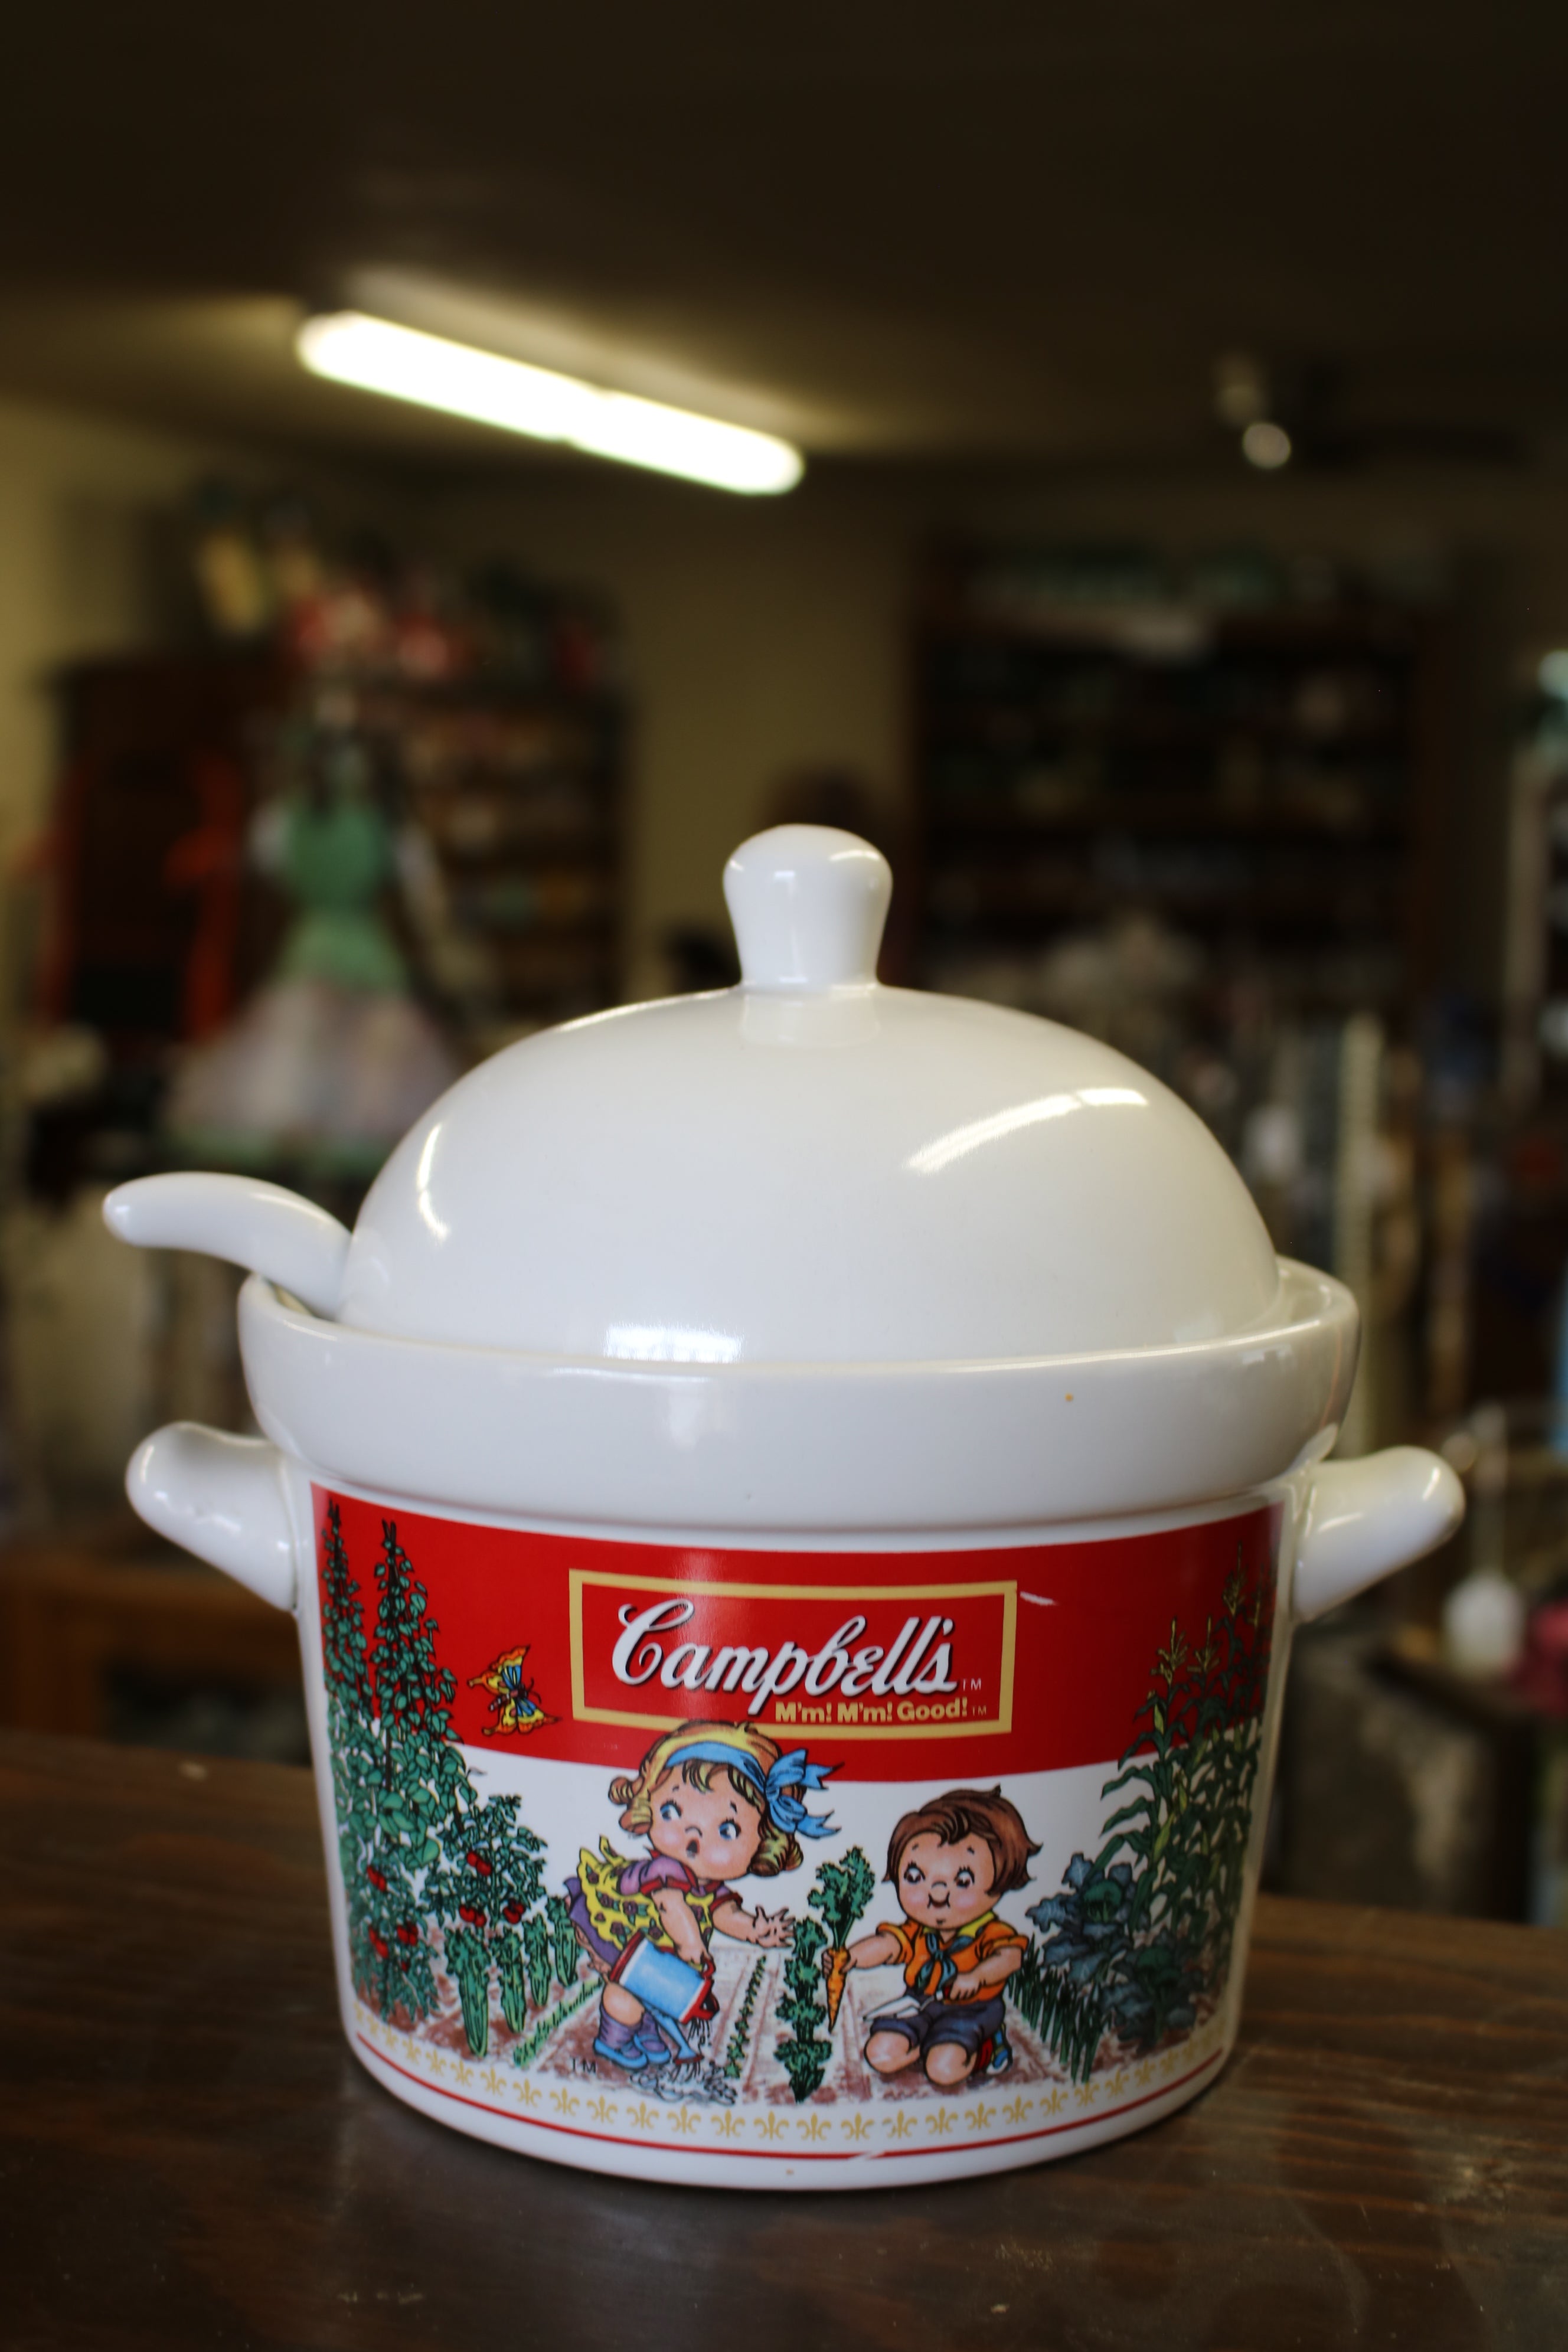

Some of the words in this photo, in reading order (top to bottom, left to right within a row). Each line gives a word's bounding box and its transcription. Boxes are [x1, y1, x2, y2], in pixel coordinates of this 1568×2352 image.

[612, 1598, 958, 1715] Campbell's
[775, 1701, 832, 1723] M'm!
[837, 1701, 893, 1722] M'm!
[897, 1696, 968, 1721] Good!
